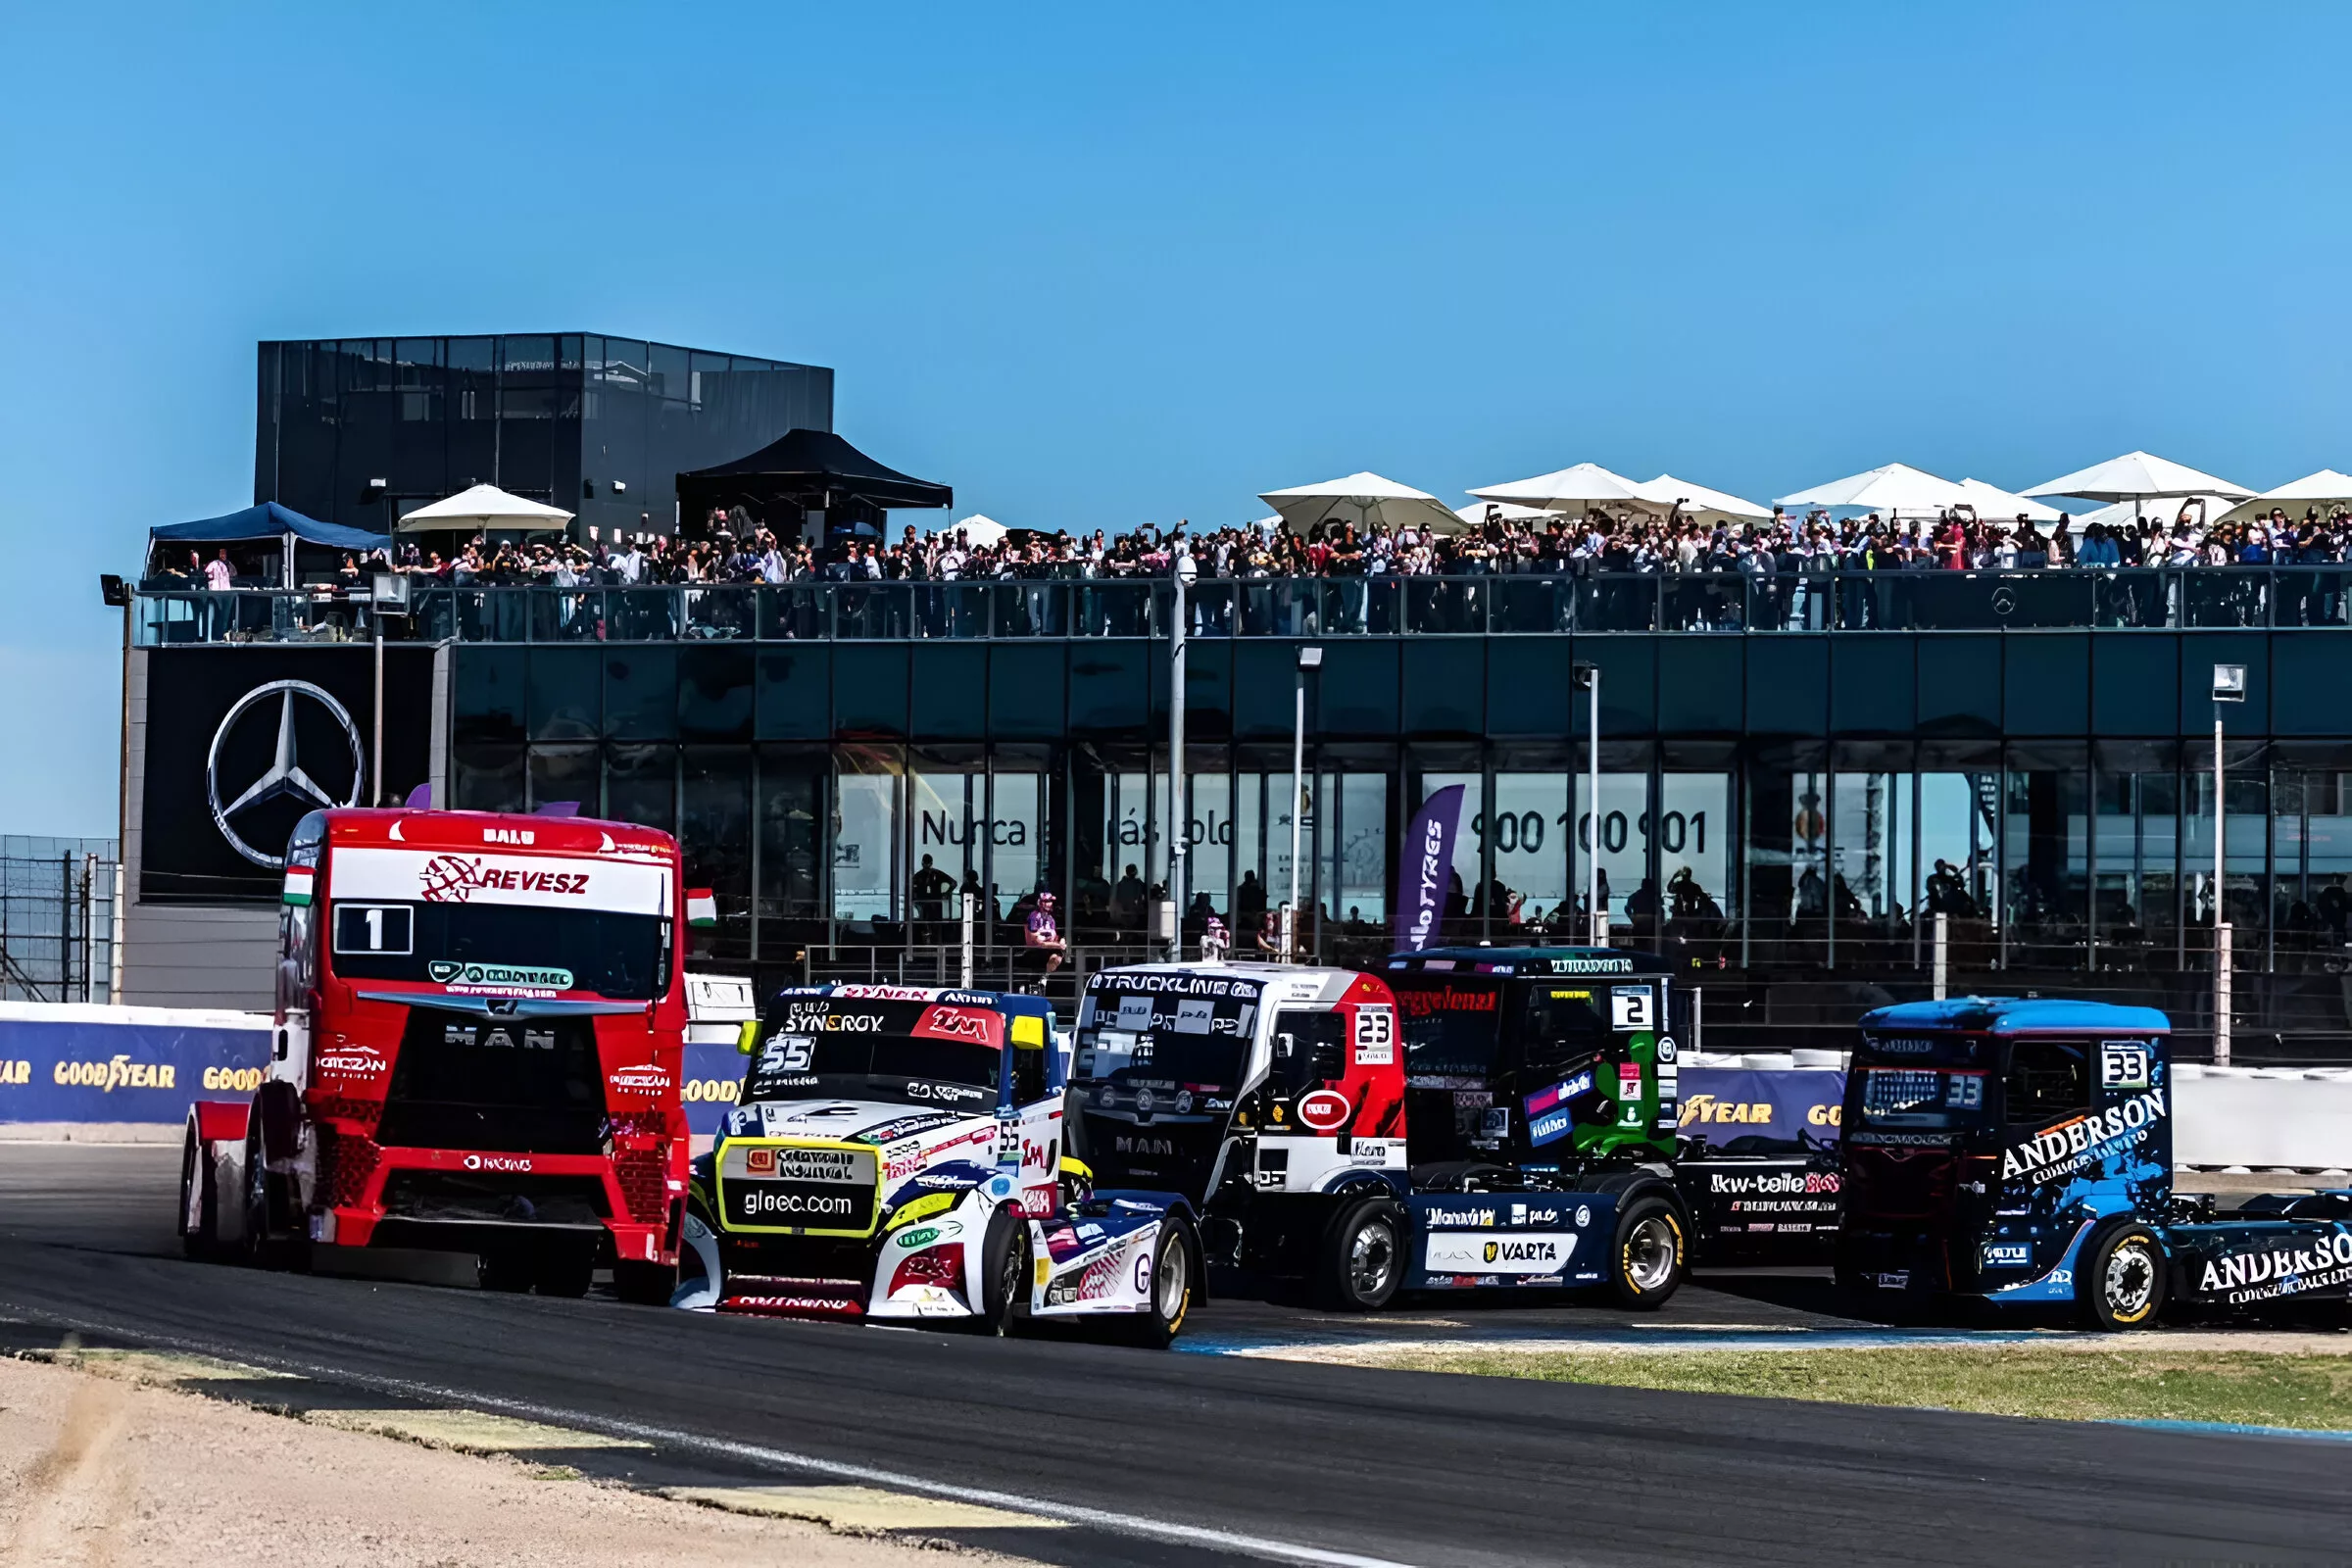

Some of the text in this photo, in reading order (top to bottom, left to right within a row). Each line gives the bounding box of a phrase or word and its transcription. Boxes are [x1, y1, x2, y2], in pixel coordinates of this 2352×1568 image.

[479, 868, 590, 895] REVESZ
[365, 909, 383, 950] 1
[1627, 997, 1644, 1023] 2
[445, 1026, 555, 1049] MAN
[1358, 1014, 1391, 1044] 23
[760, 1038, 812, 1072] 55
[2106, 1053, 2143, 1082] 33
[54, 1054, 175, 1092] GOODYEAR
[1000, 1120, 1019, 1152] 55
[1115, 1136, 1173, 1155] MAN
[2002, 1088, 2167, 1180] ANDERSON
[1501, 1242, 1557, 1261] VARTA
